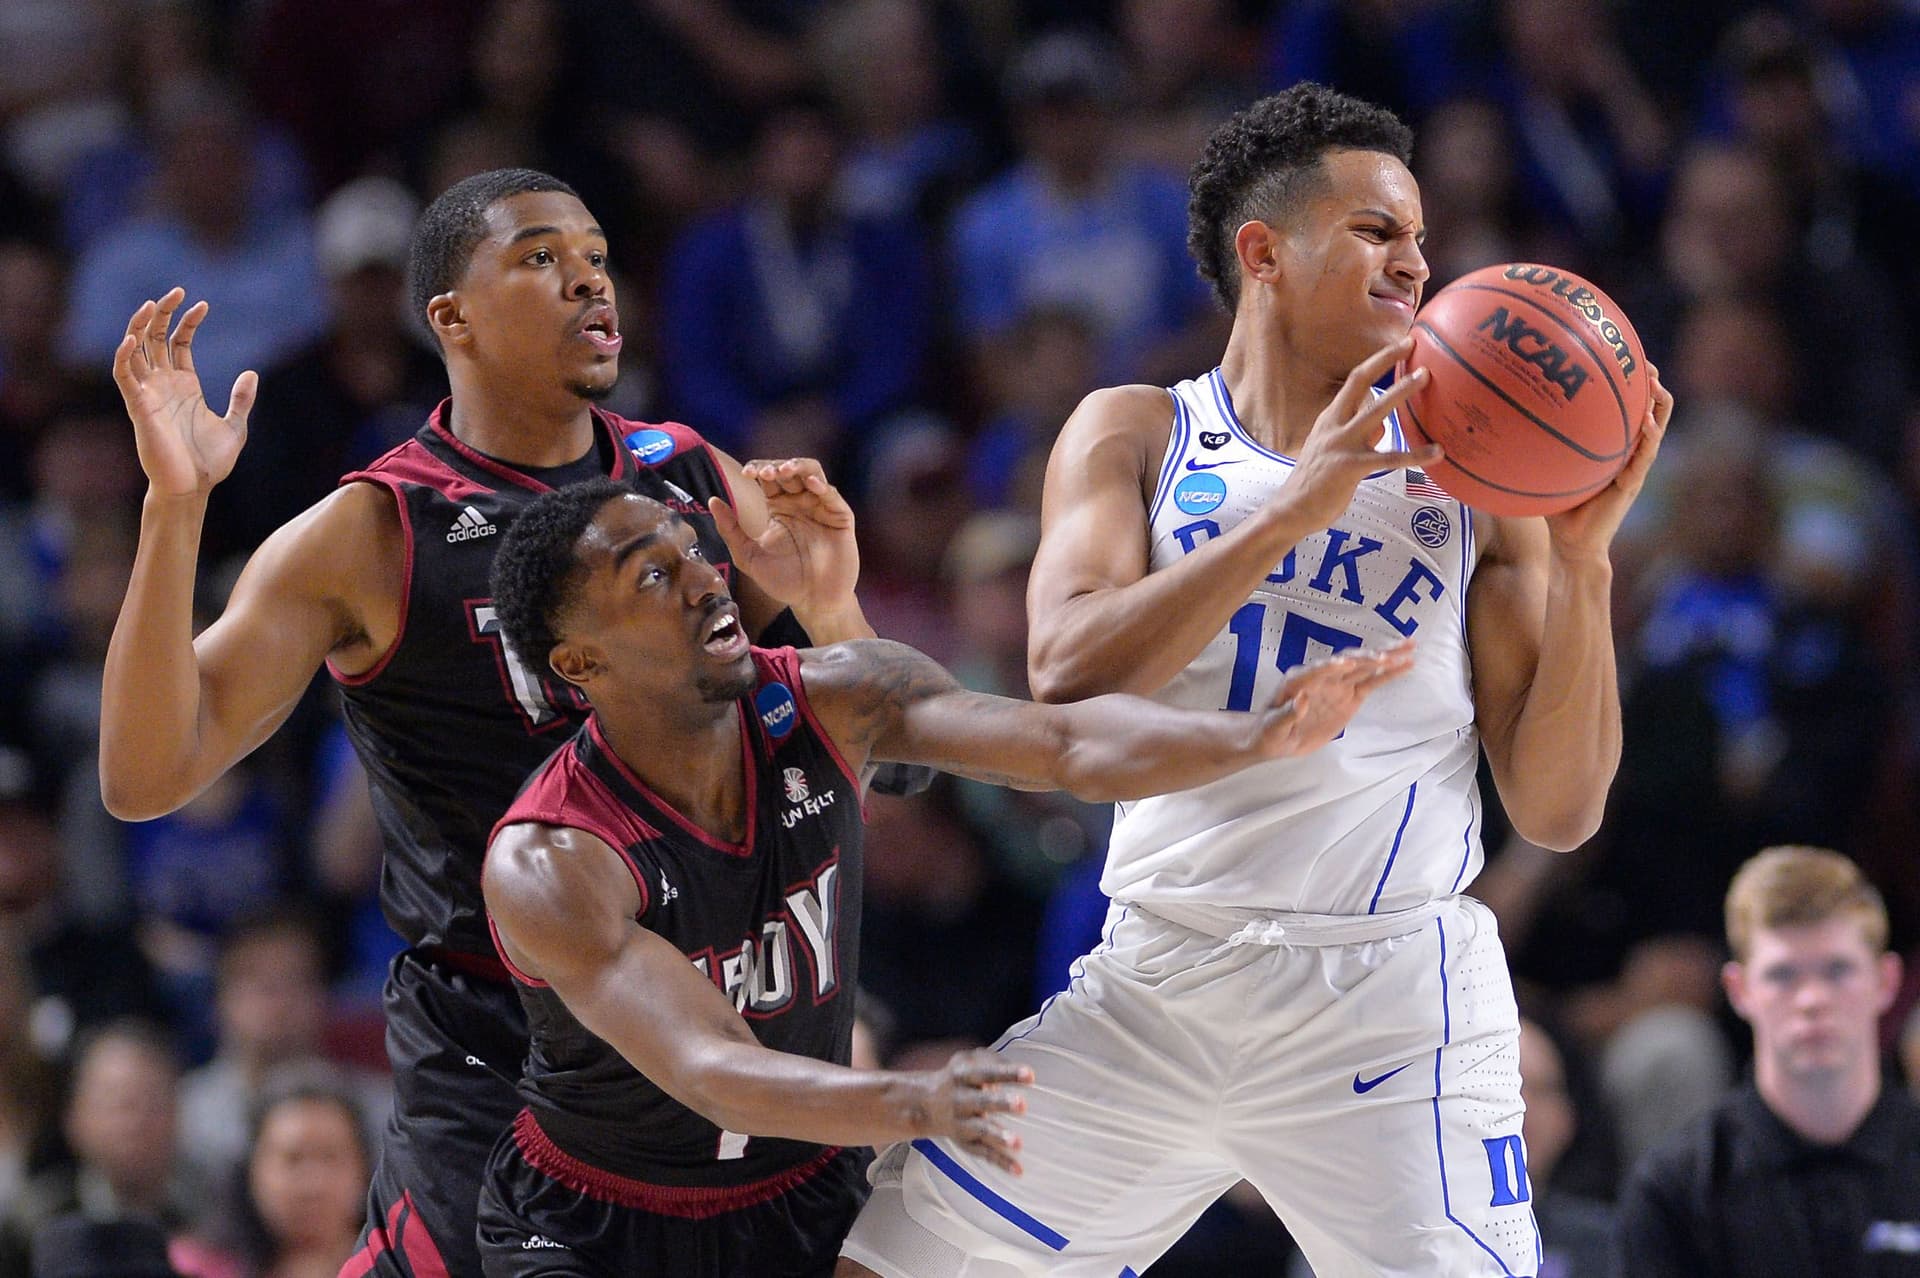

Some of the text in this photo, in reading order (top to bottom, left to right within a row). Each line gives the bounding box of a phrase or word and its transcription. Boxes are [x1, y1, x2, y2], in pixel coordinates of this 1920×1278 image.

[1476, 306, 1588, 401] NCAA
[1203, 434, 1226, 445] KB
[1179, 491, 1222, 503] NCAA
[446, 524, 497, 543] adidas
[1172, 518, 1445, 638] DKE
[762, 699, 794, 728] NCAA
[691, 858, 839, 1016] ROY
